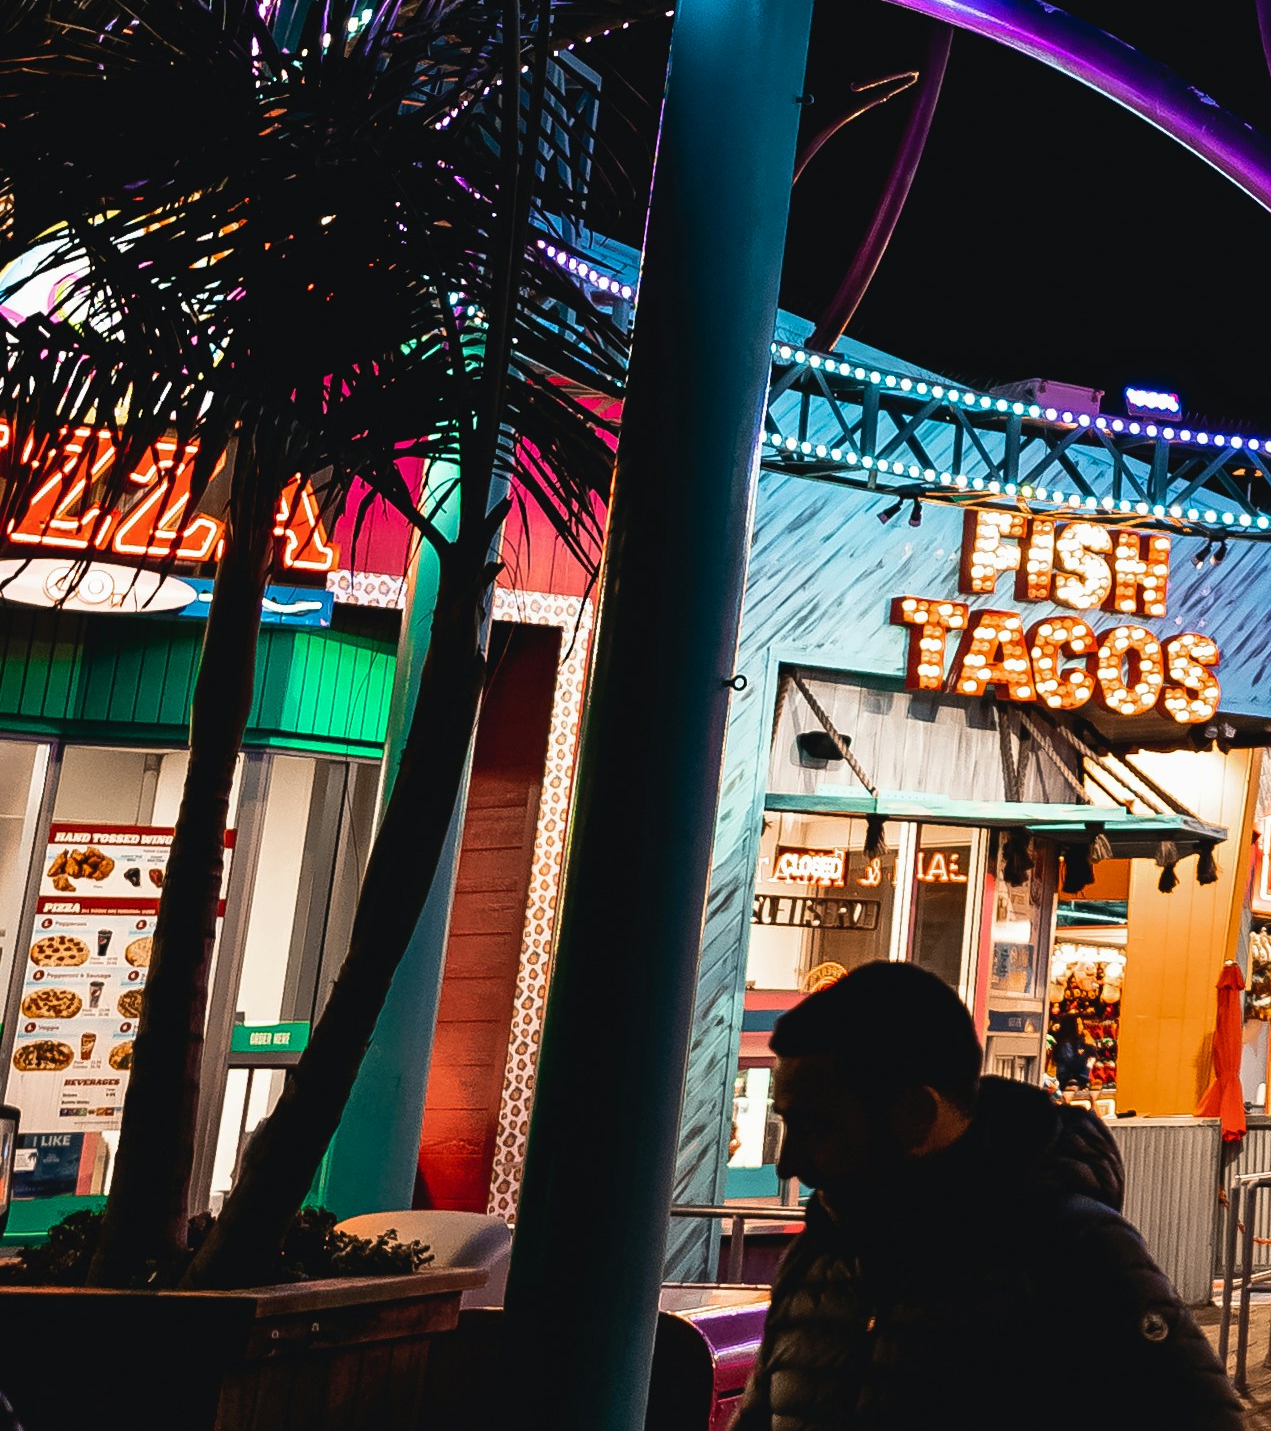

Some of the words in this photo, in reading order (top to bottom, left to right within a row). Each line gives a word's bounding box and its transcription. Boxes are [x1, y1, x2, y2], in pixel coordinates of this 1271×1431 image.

[959, 509, 1171, 618] FISH
[891, 597, 1221, 724] TACOS
[43, 903, 80, 913] PIZZA
[64, 1078, 120, 1086] BEVERAGES
[41, 1135, 71, 1147] LIKE
